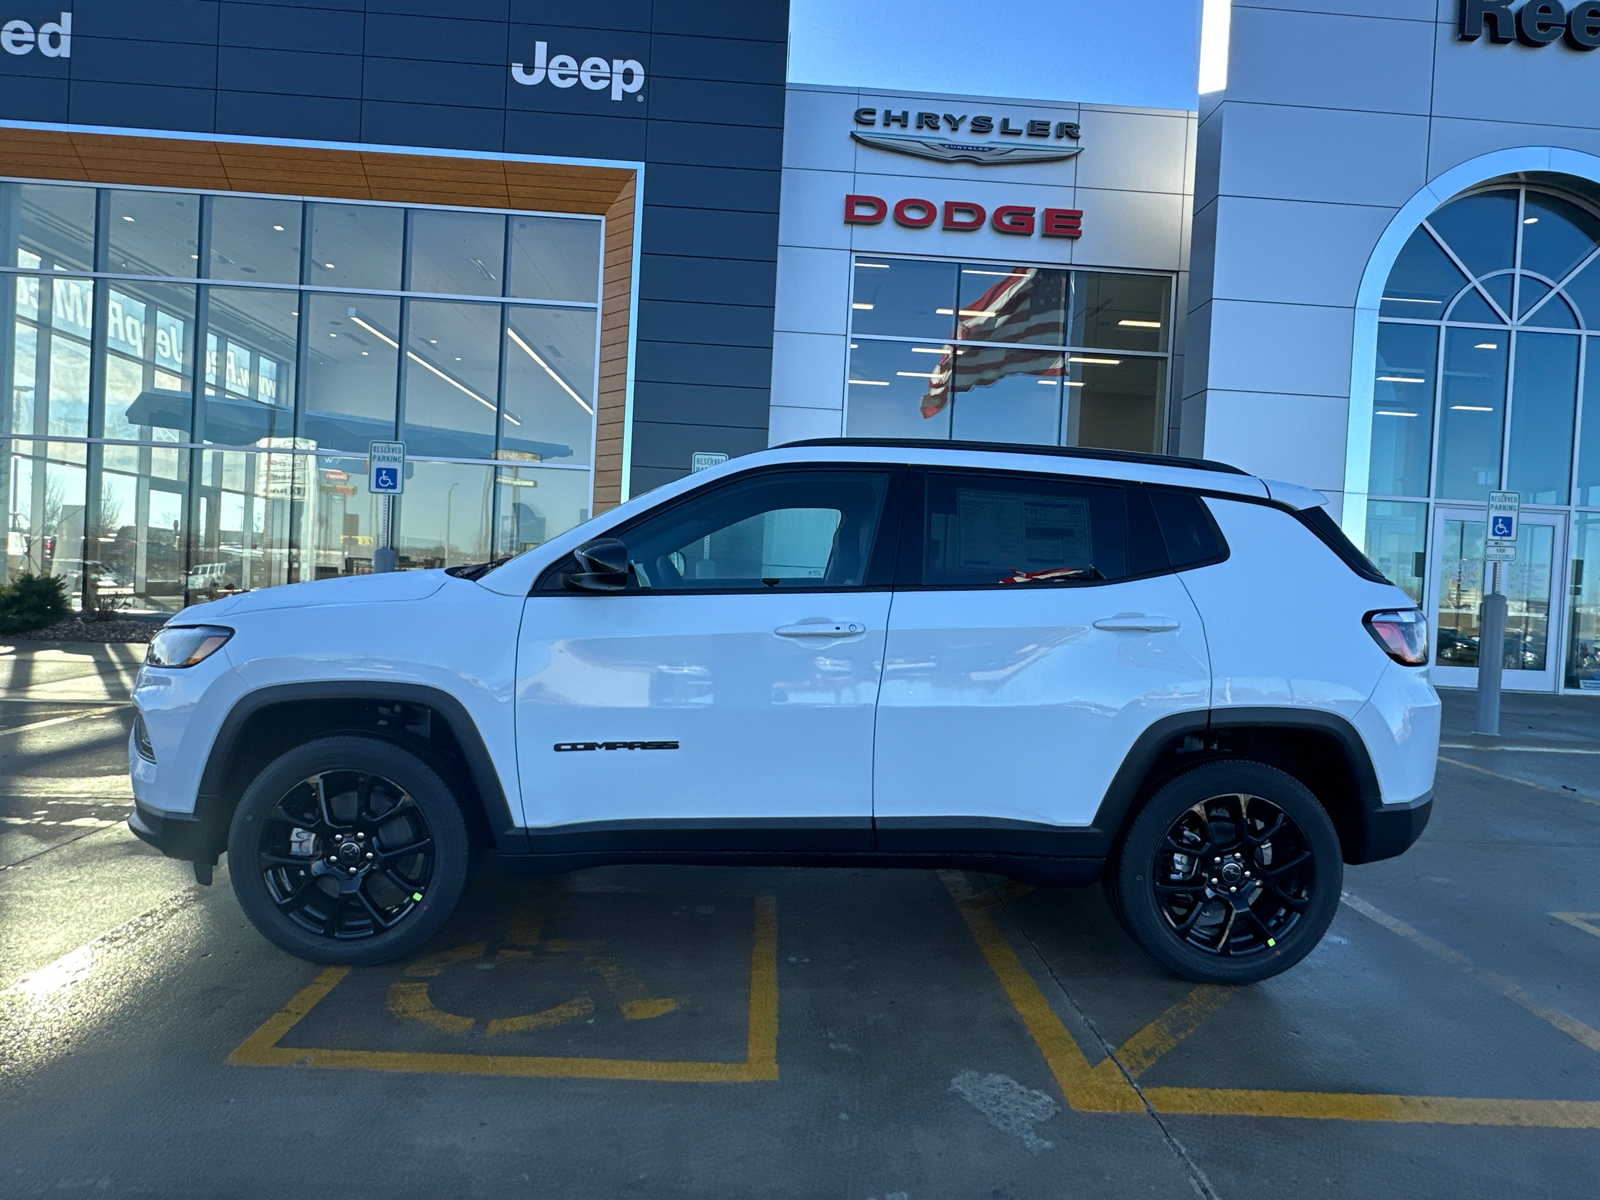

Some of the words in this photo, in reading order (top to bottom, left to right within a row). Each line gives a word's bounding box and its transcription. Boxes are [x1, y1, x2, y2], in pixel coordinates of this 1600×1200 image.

[1, 12, 72, 57] ed
[511, 41, 645, 101] Jeep
[854, 108, 1081, 138] CHRYSLER
[844, 194, 1083, 238] DODGE
[372, 446, 402, 454] RESERVED
[372, 455, 402, 463] PARKING
[1490, 495, 1518, 503] RESERVED
[553, 741, 680, 752] COMPASS
